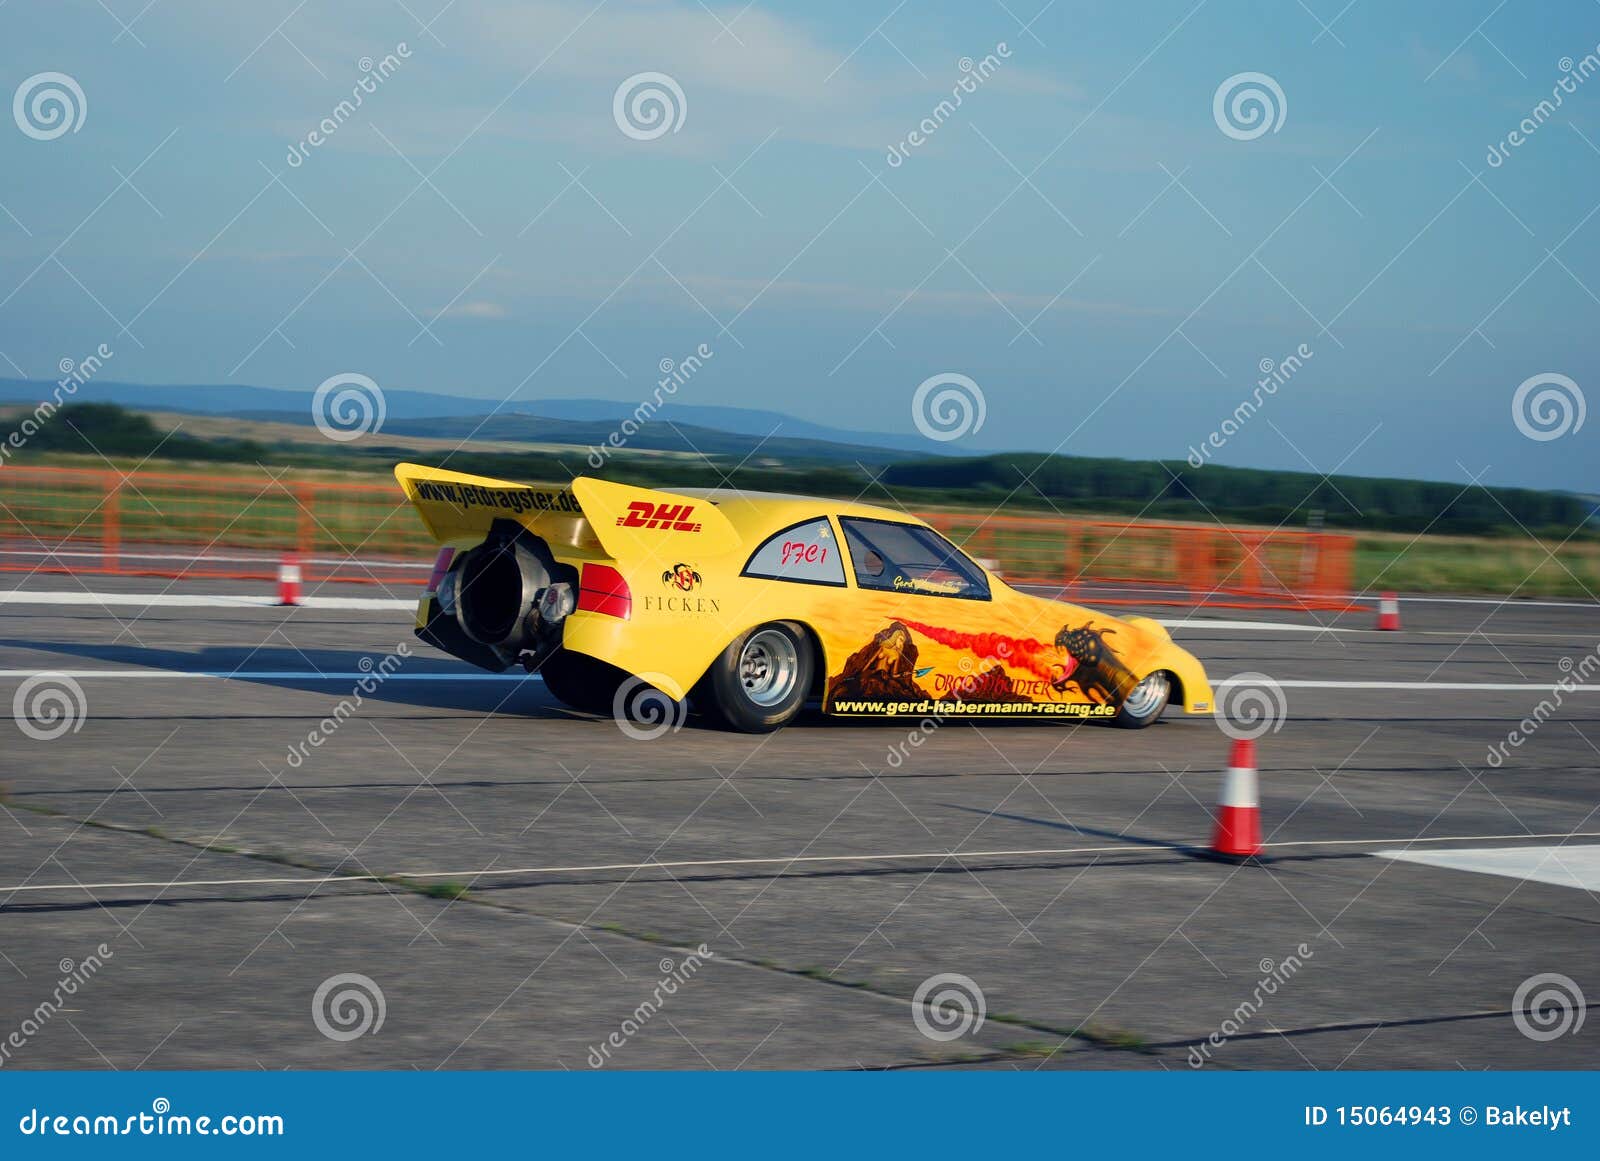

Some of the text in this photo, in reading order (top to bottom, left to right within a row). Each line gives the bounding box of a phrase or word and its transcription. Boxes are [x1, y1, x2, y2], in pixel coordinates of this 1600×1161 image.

[415, 482, 582, 513] www.jetdragster.de
[616, 501, 702, 532] DHL
[643, 596, 720, 613] FICKEN
[835, 699, 1116, 717] www.gerd-habermann-racing.de
